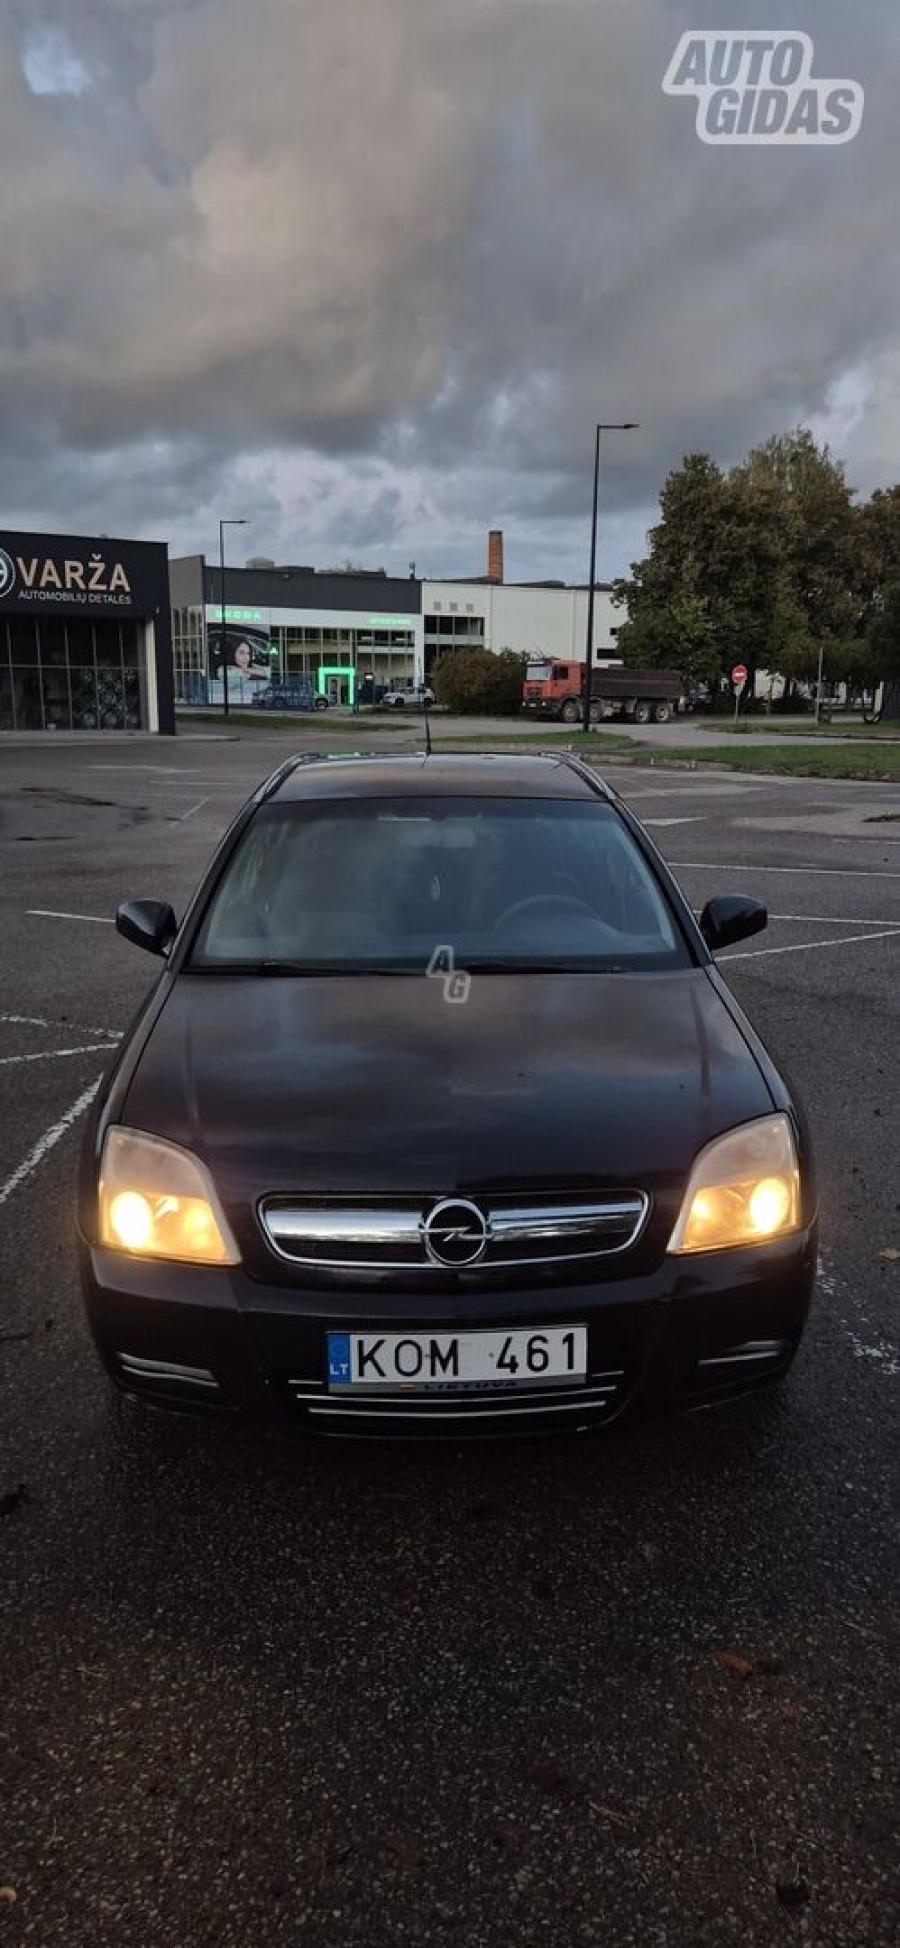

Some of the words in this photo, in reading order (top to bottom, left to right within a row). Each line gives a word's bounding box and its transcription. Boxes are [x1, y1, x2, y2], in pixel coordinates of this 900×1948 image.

[18, 553, 130, 592] VARŽA
[330, 1362, 348, 1375] LT
[356, 1338, 459, 1377] KOM
[496, 1332, 575, 1374] 461
